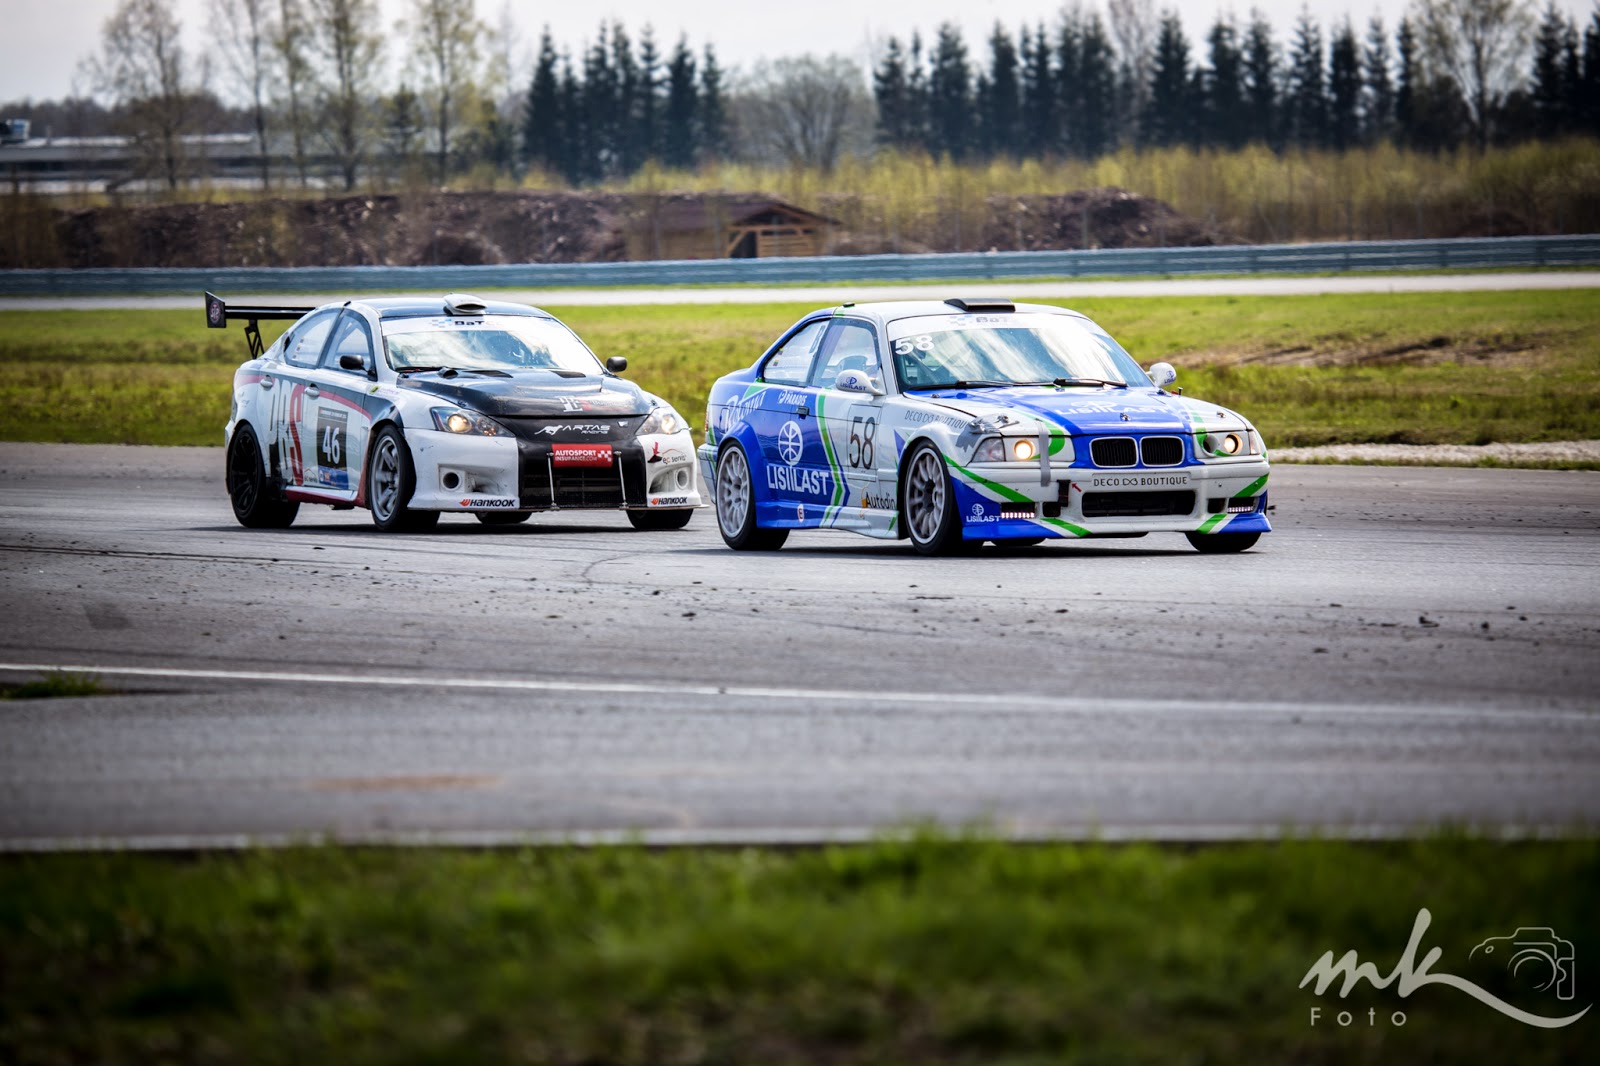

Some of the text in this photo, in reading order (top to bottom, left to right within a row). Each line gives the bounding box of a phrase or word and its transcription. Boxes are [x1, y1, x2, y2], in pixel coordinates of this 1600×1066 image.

[895, 335, 935, 355] 58
[904, 410, 922, 422] DECO
[322, 425, 341, 465] 46
[848, 416, 876, 470] 58
[1093, 478, 1120, 487] DECO
[1141, 476, 1188, 486] BOUTIQUE
